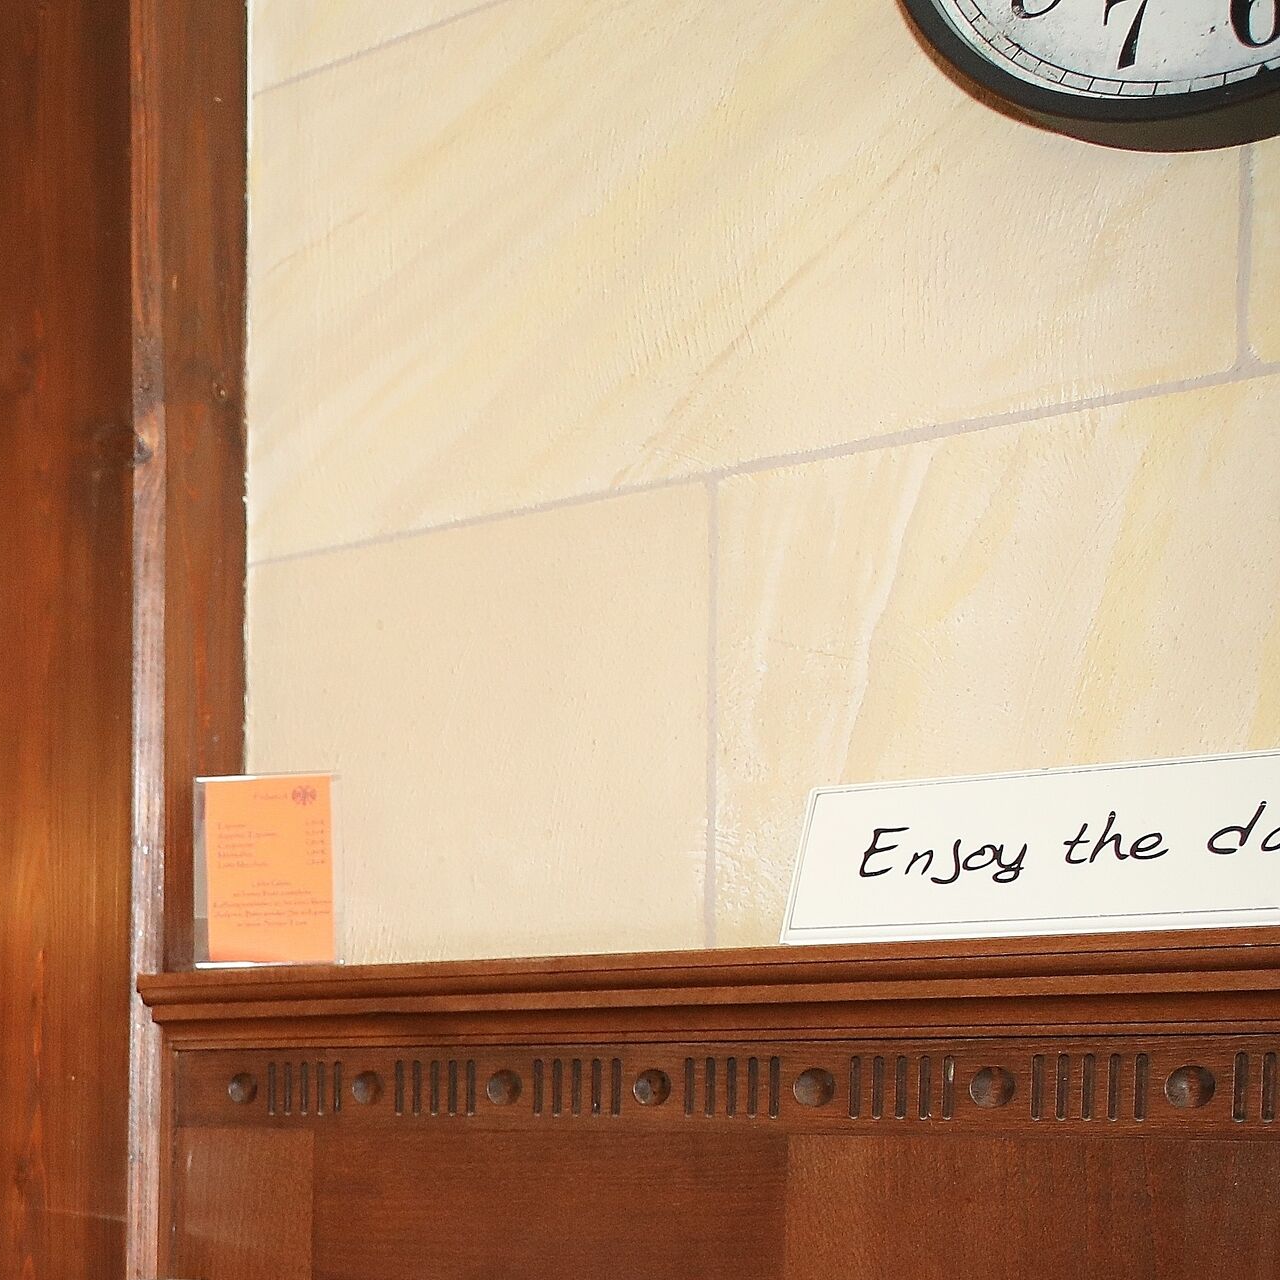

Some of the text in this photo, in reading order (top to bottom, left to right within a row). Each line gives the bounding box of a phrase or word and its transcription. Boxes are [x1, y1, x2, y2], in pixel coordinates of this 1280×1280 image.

[1102, 0, 1148, 70] 7
[858, 826, 1028, 885] Enjoy
[1062, 810, 1170, 865] the
